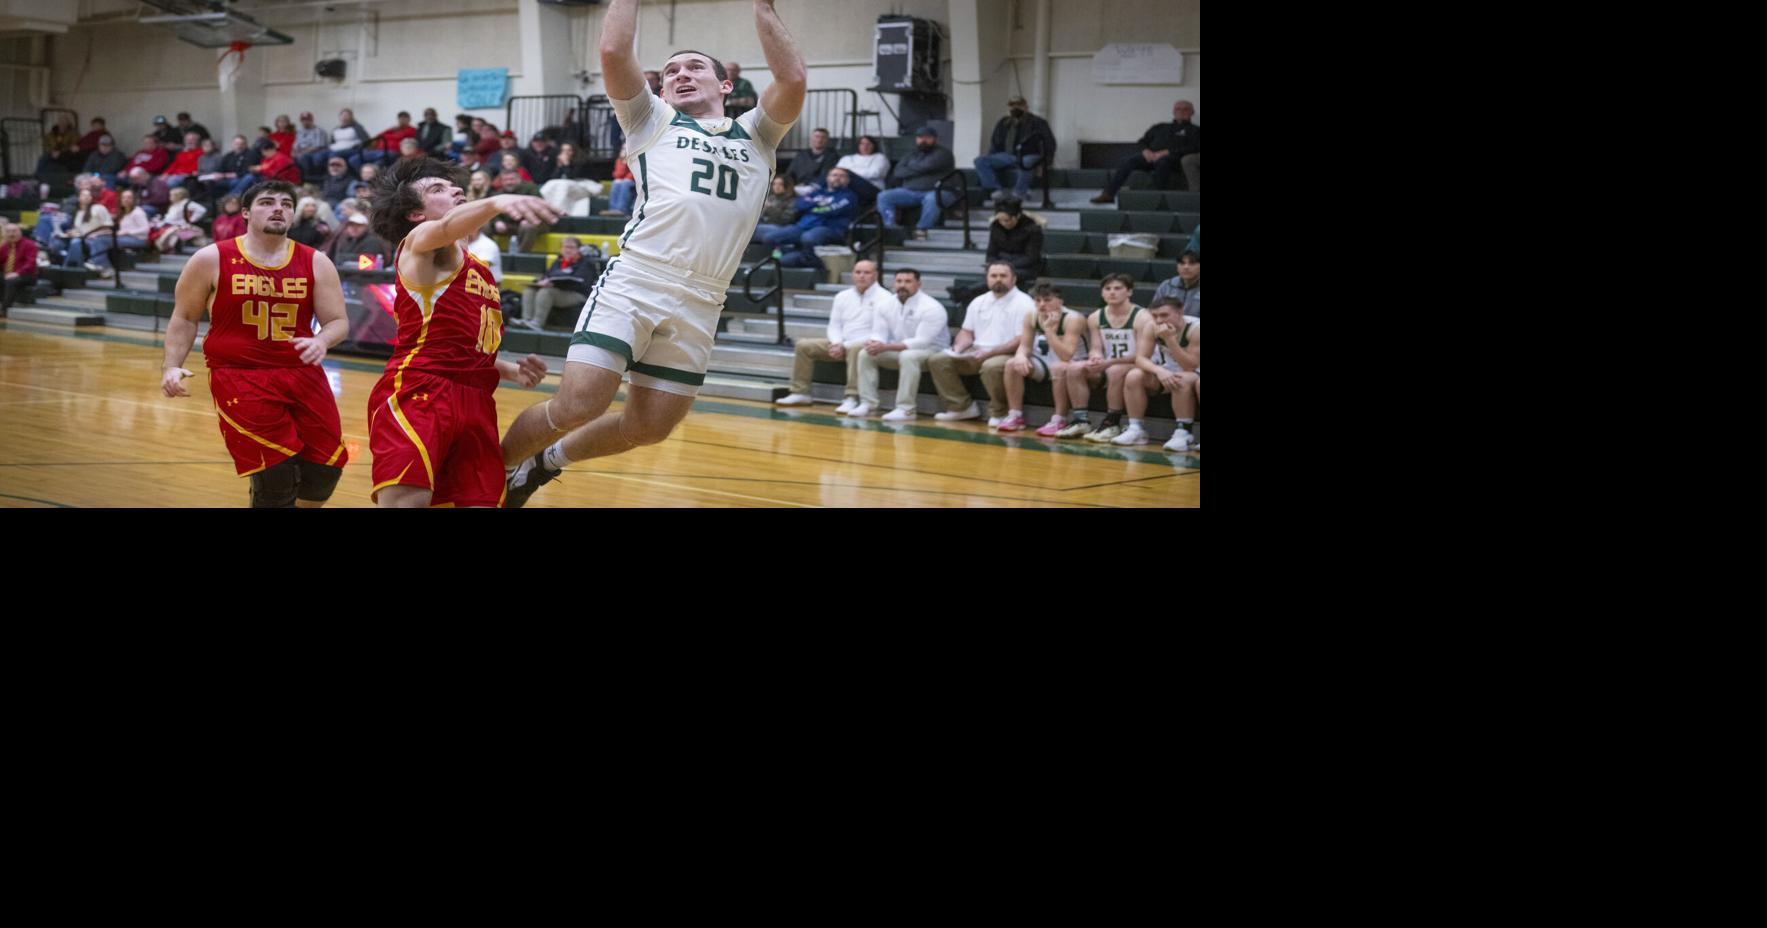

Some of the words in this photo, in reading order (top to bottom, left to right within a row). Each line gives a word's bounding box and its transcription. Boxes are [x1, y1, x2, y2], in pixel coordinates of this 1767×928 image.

[690, 157, 739, 201] 20
[231, 273, 308, 299] EAGLES
[241, 300, 299, 341] 42
[475, 303, 504, 355] 10
